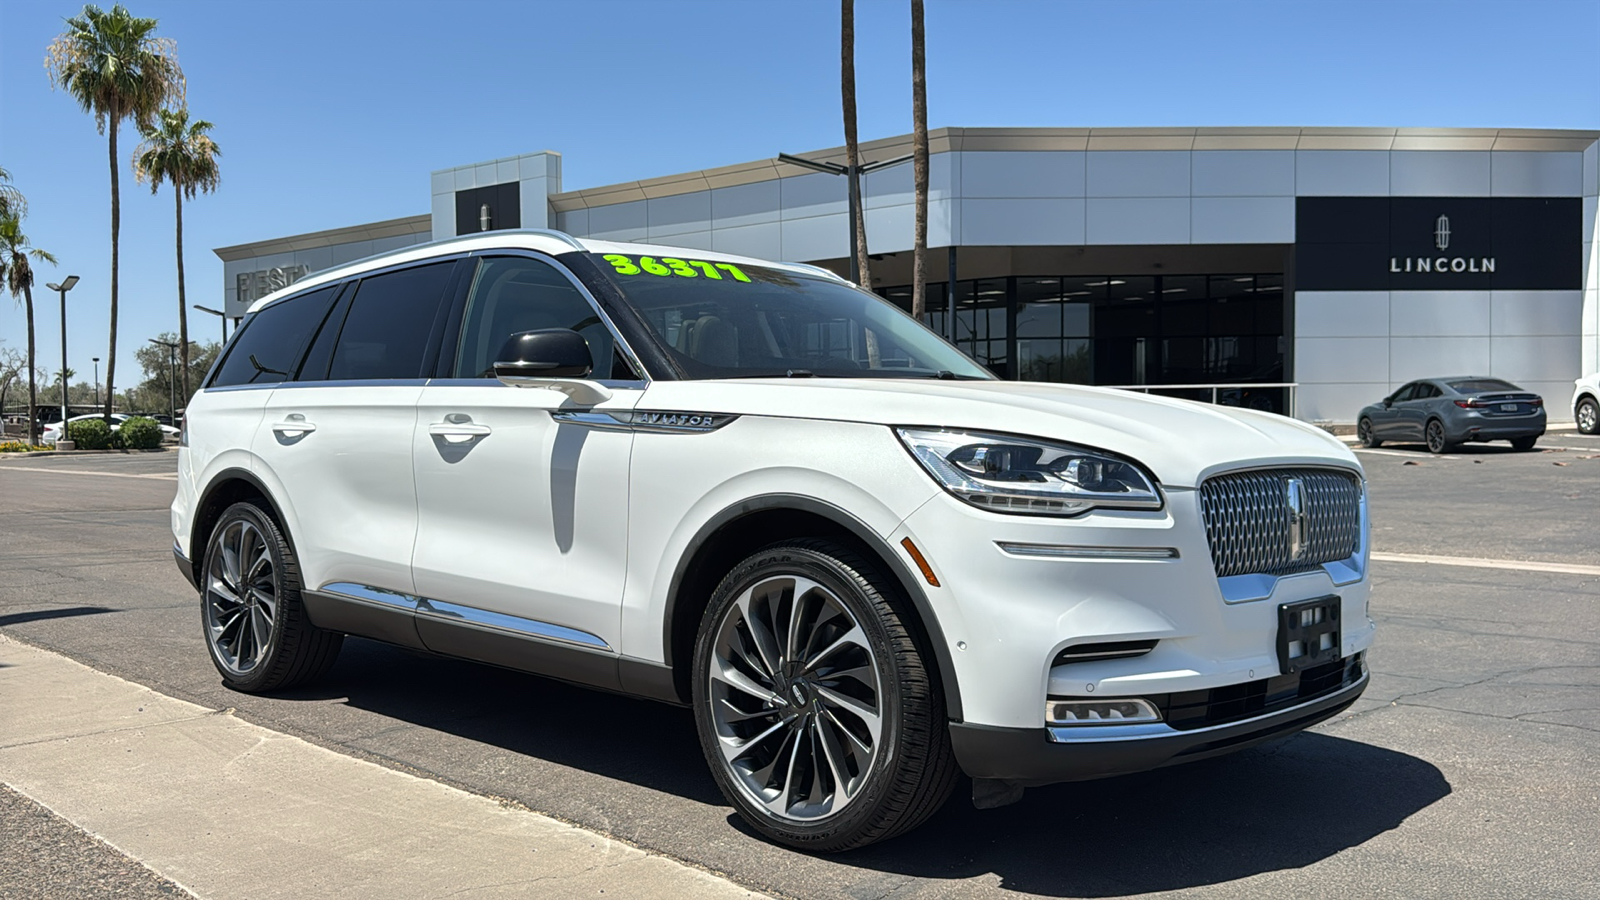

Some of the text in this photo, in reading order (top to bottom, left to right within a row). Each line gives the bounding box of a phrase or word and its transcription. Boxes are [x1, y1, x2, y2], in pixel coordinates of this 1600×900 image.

[602, 254, 752, 283] 36377
[1390, 257, 1496, 273] LINCOLN
[641, 413, 713, 426] AVIATOR
